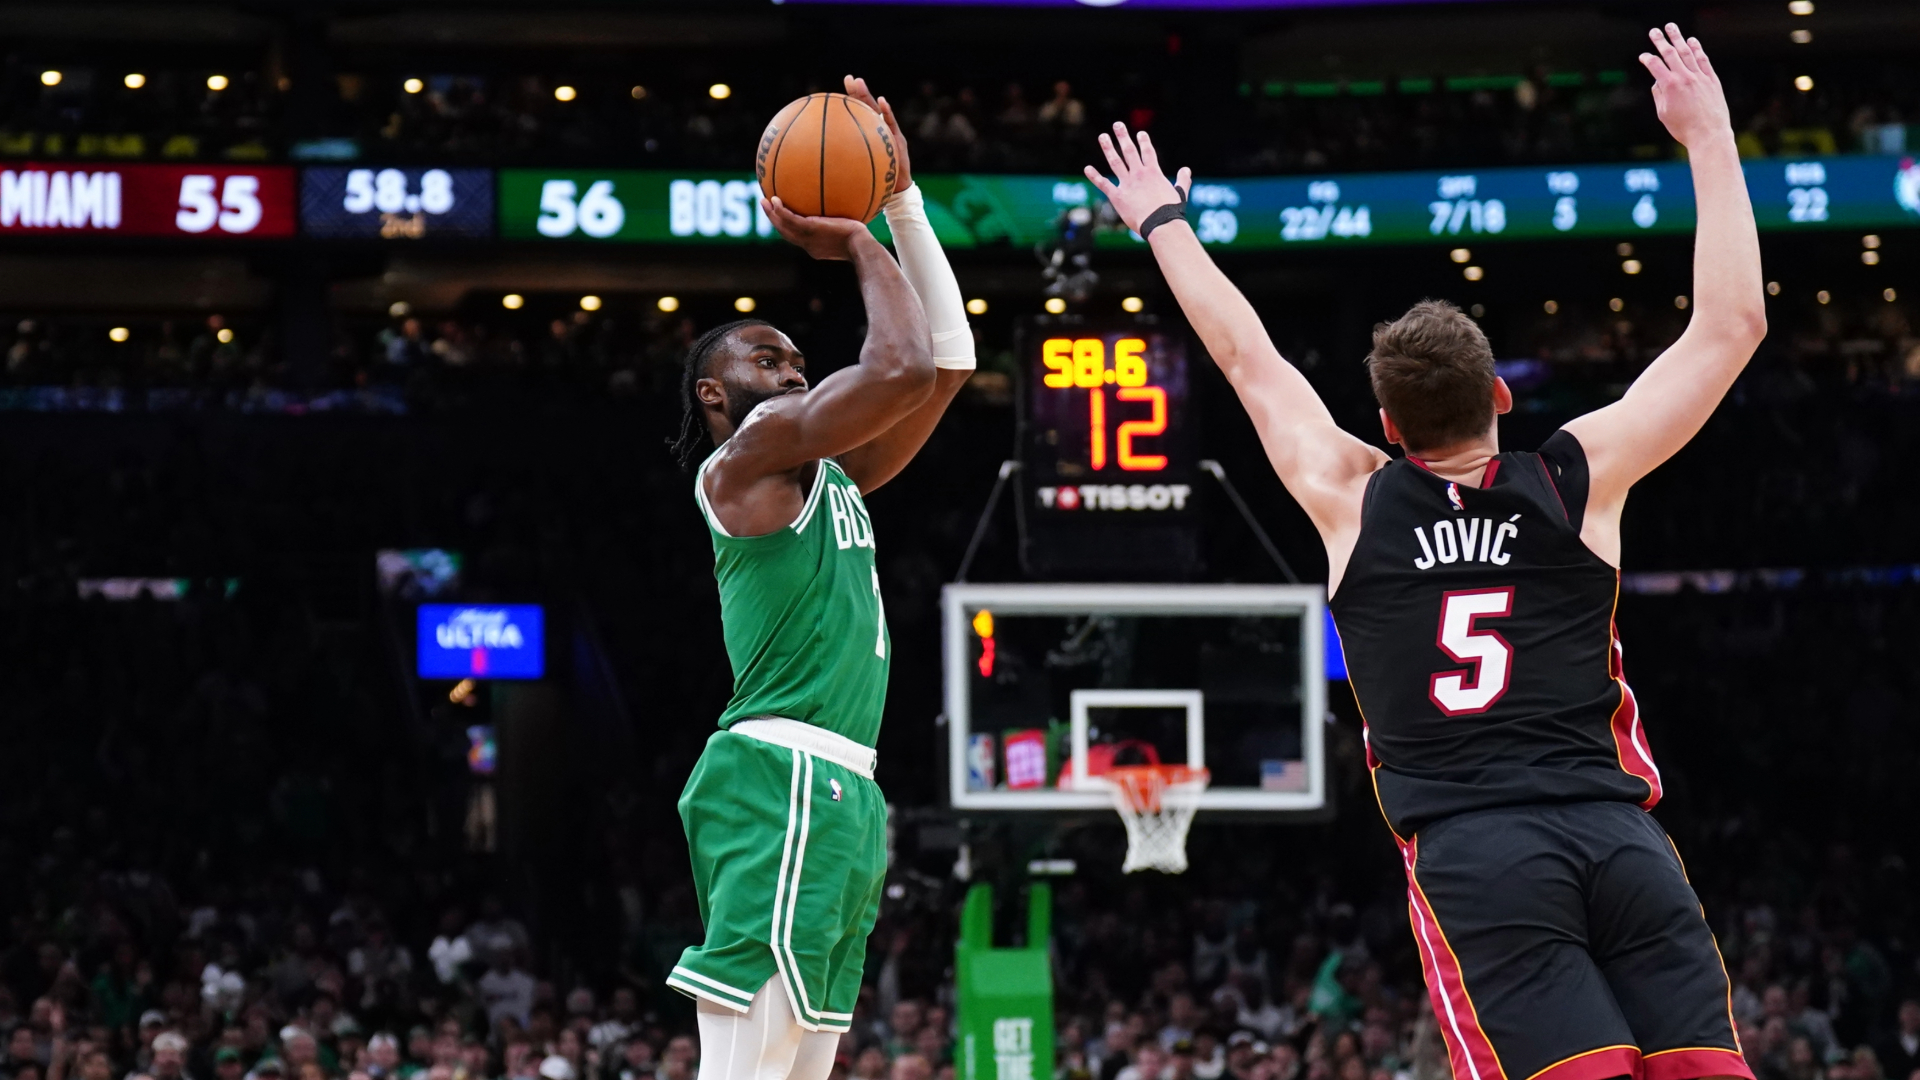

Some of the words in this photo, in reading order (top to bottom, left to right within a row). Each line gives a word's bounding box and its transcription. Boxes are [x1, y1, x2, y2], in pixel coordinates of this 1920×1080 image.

[1, 170, 122, 229] MIAMI
[175, 174, 262, 234] 55
[343, 168, 454, 214] 58.8
[536, 179, 626, 238] 56
[1632, 194, 1658, 228] 6
[1787, 187, 1829, 222] 22
[1196, 208, 1238, 243] 50
[1279, 204, 1372, 241] 22/44
[1552, 196, 1577, 231] 5
[1043, 339, 1147, 388] 58.6
[1090, 386, 1168, 471] 12
[1079, 484, 1191, 511] TISSOT
[1414, 514, 1522, 570] JOVIĆ
[436, 623, 524, 650] ULTRA
[1428, 585, 1516, 718] 5
[993, 1018, 1034, 1053] GET
